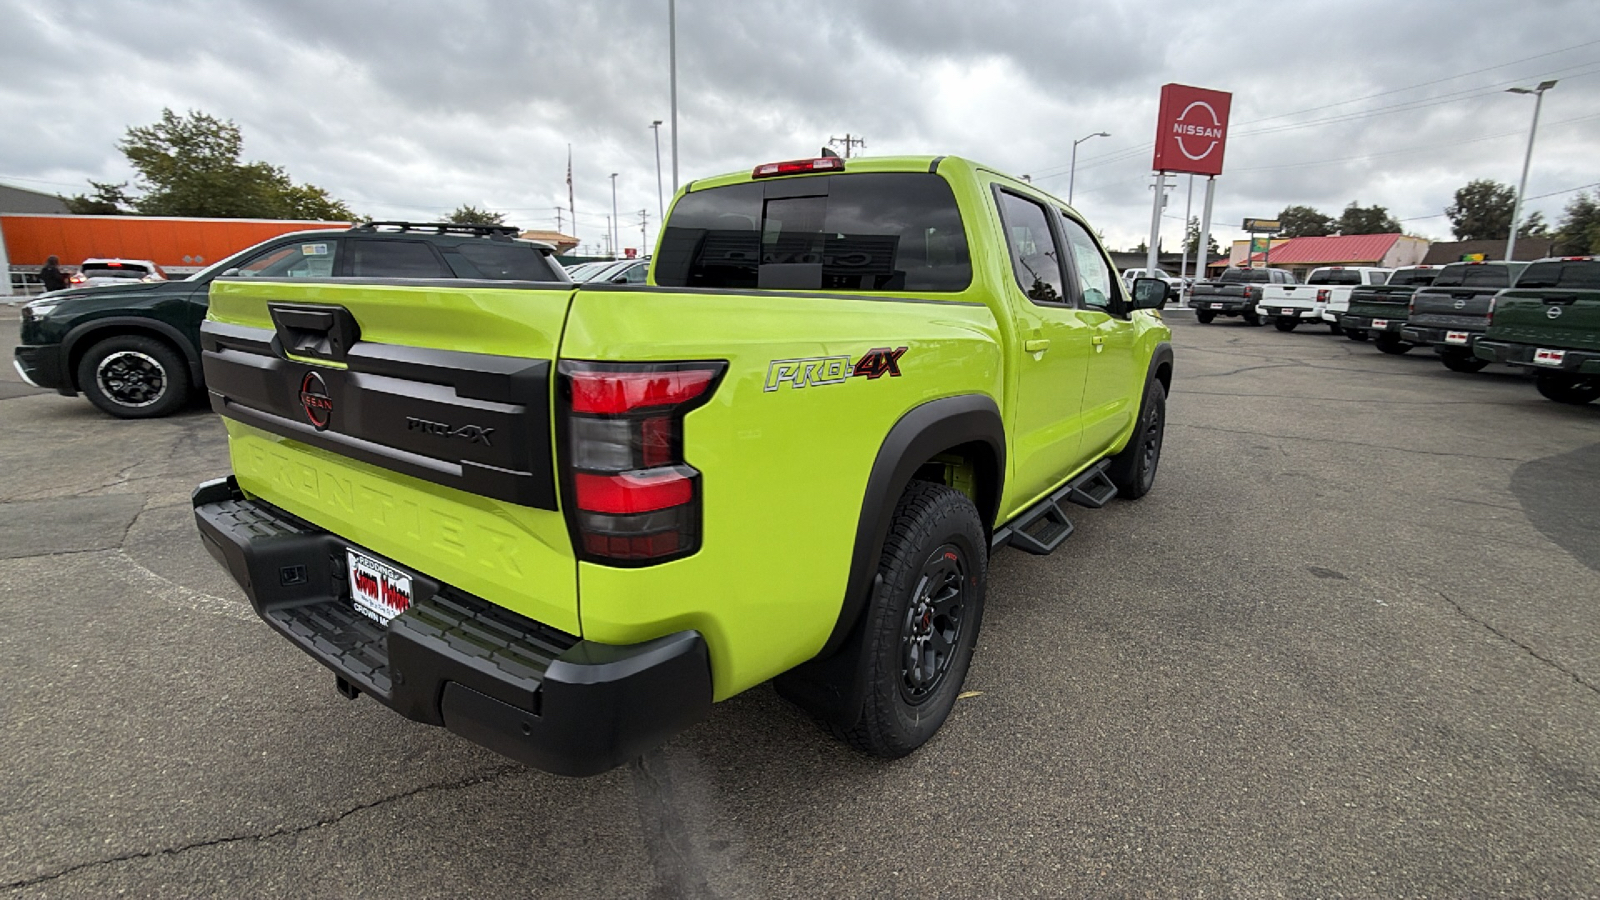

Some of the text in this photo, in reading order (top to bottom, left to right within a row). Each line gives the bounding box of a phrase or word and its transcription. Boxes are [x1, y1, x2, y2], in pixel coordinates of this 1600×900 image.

[1173, 123, 1222, 138] NISSAN
[763, 346, 909, 393] PRO-4X
[301, 394, 333, 411] SSAN
[246, 442, 524, 578] FRONTIER
[359, 557, 394, 577] REDDING
[354, 603, 379, 623] CROWN
